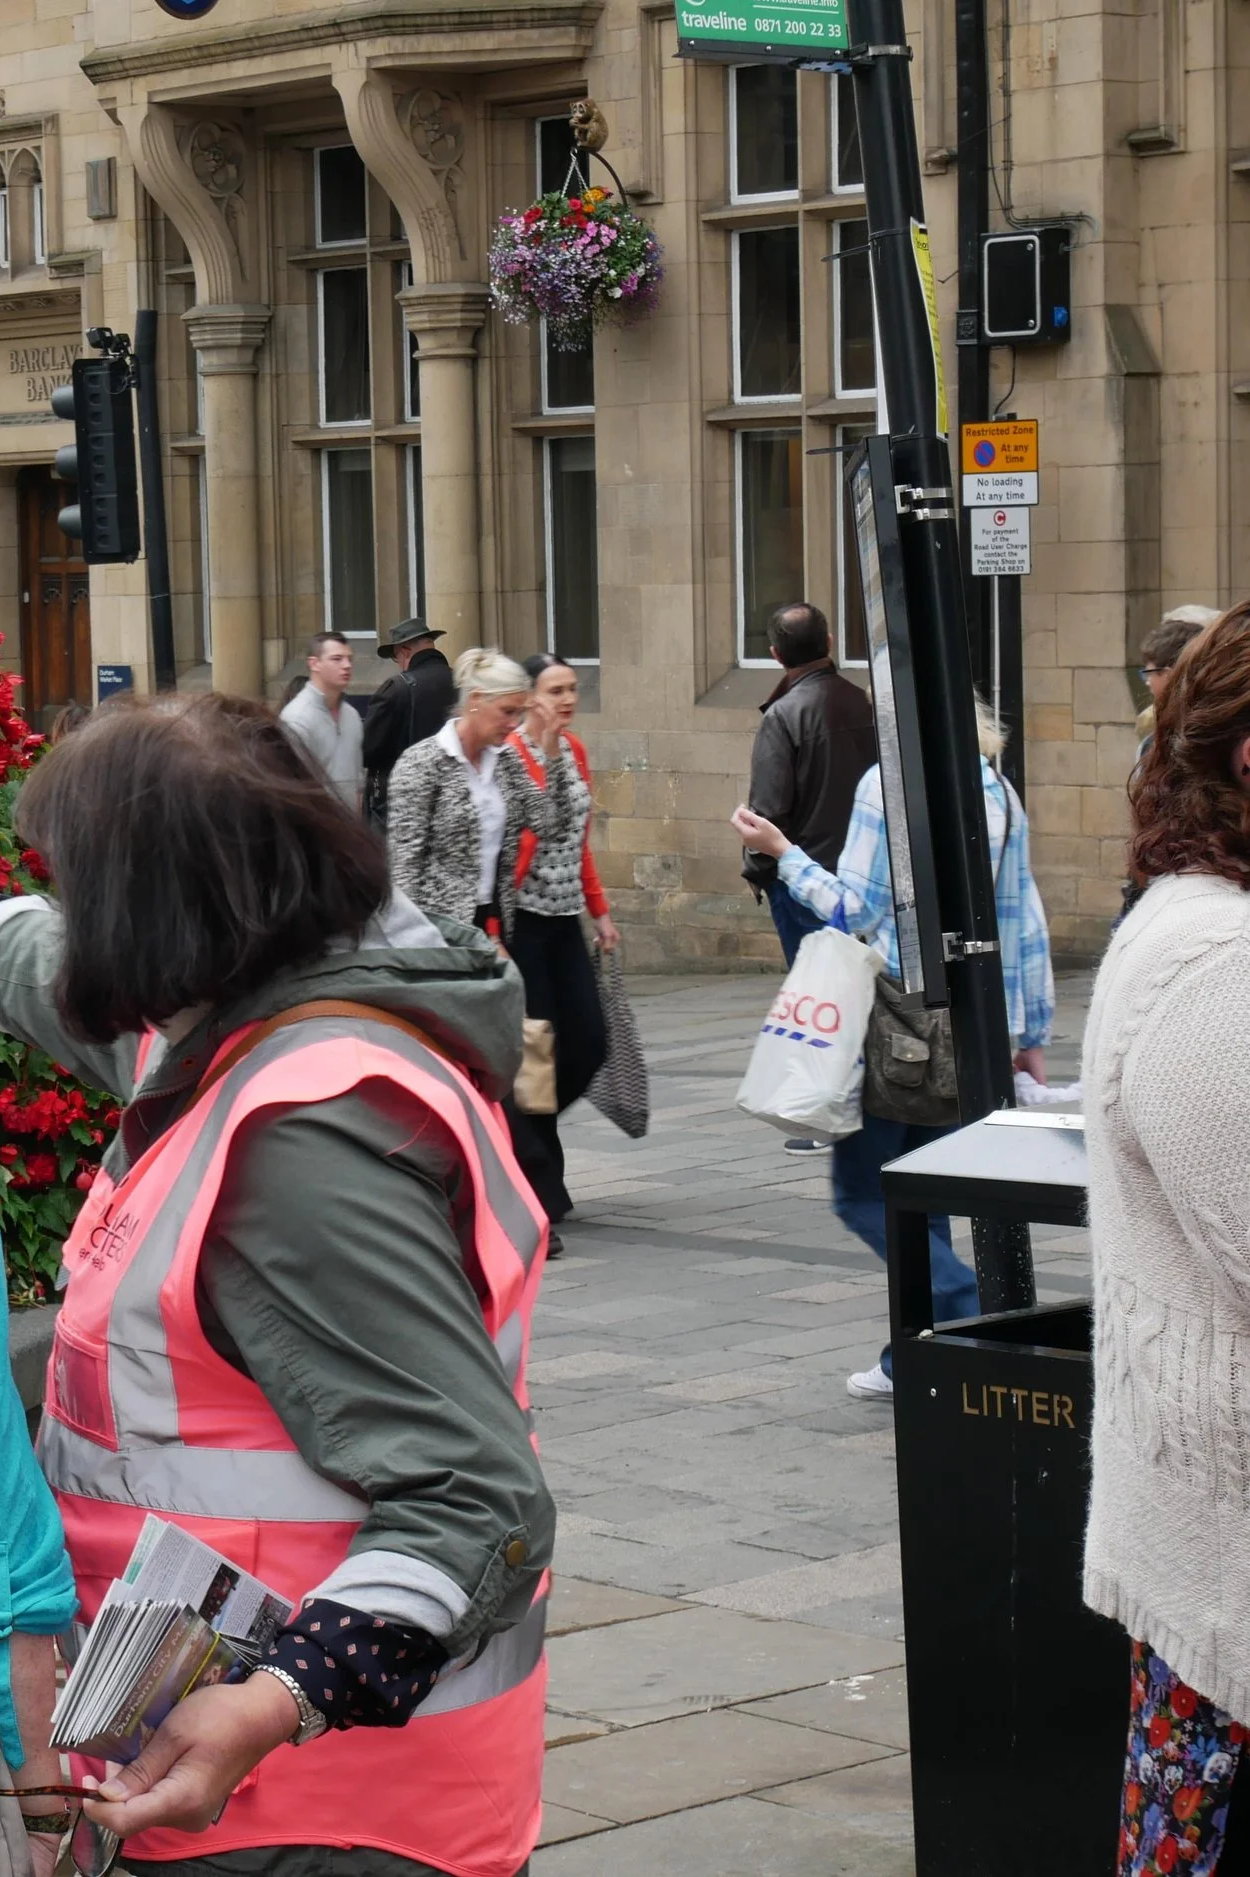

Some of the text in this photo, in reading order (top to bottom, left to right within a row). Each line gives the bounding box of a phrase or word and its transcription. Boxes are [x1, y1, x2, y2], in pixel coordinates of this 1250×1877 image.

[681, 10, 747, 32] traveline
[754, 18, 842, 38] 0871 200 22 33
[965, 425, 1034, 437] Restricted Zone
[1000, 444, 1029, 453] At any
[1005, 455, 1024, 464] time
[977, 477, 1024, 487] No loading
[976, 491, 1025, 502] At any time
[993, 528, 1019, 536] payment
[961, 1381, 1076, 1429] LITTER
[113, 1680, 154, 1737] Durham
[151, 1648, 173, 1678] City
